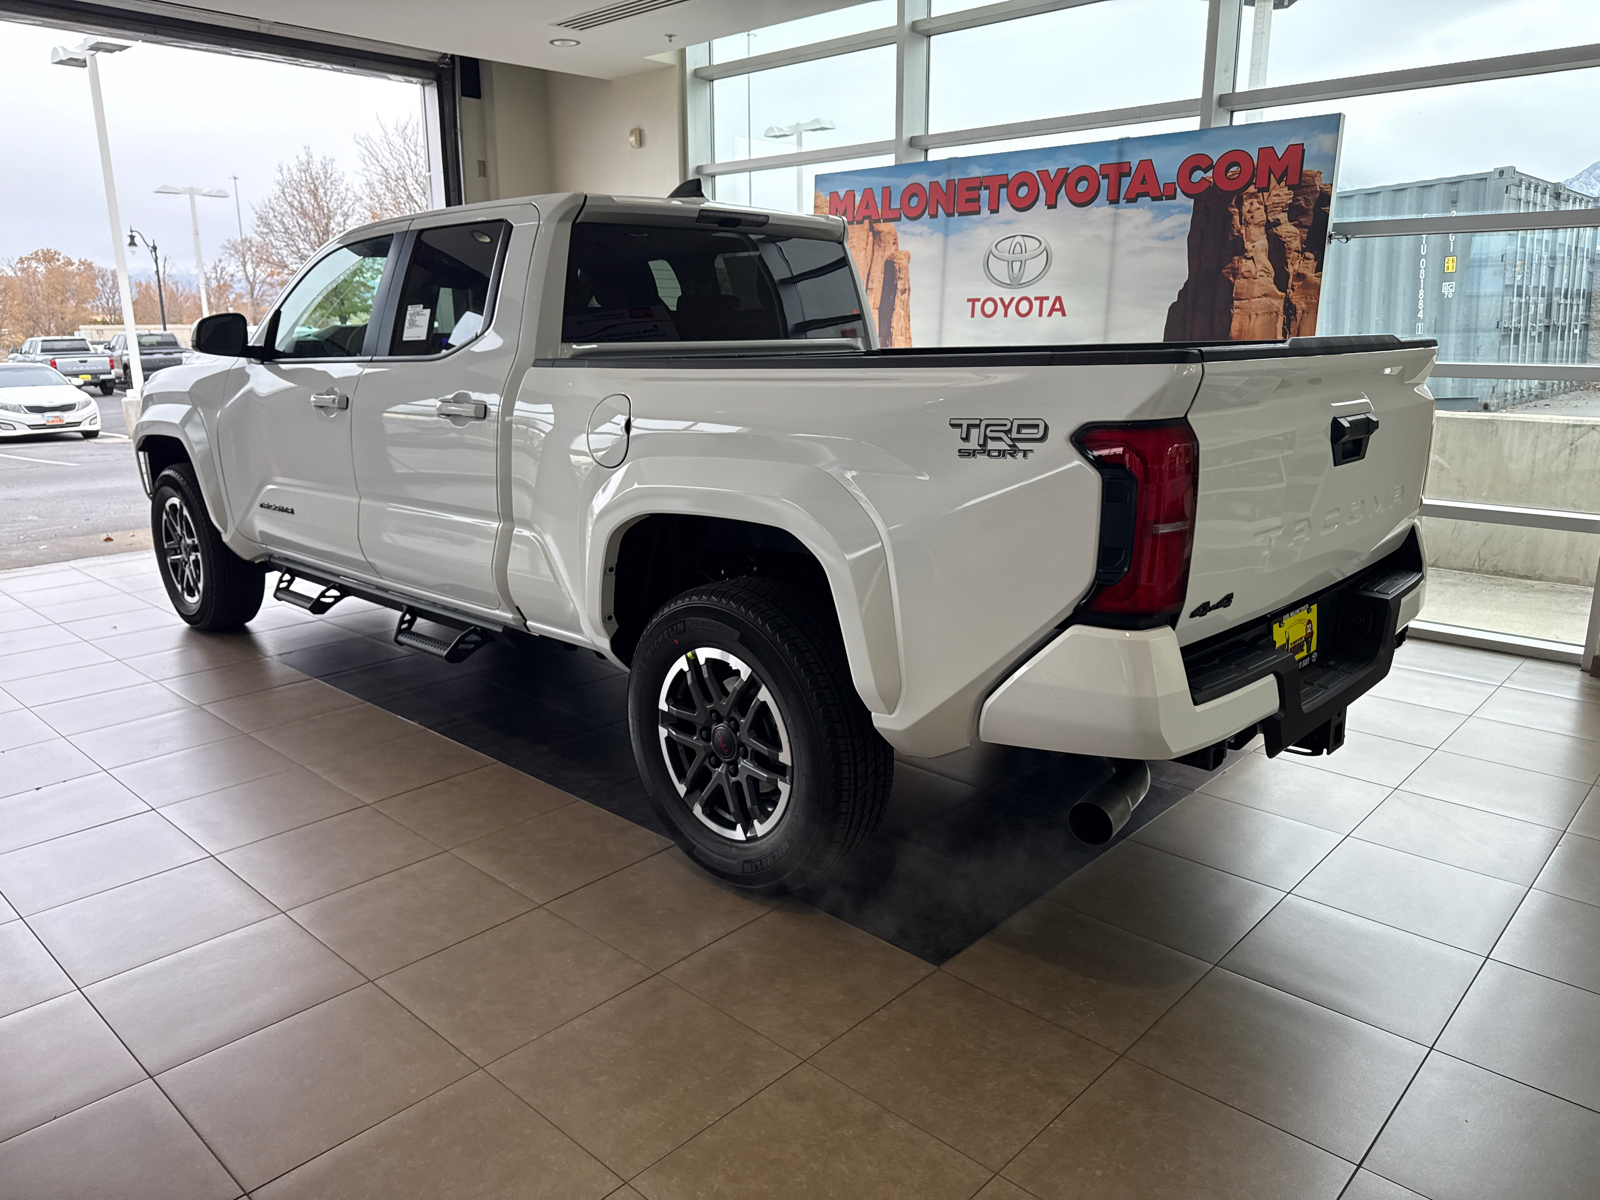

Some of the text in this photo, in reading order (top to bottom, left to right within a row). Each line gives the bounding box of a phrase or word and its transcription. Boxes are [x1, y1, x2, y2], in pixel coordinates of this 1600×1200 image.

[828, 143, 1305, 225] MALONETOYOTA.COM
[966, 295, 1067, 319] TOYOTA
[949, 418, 1049, 449] TRD
[957, 448, 1034, 459] SPORT
